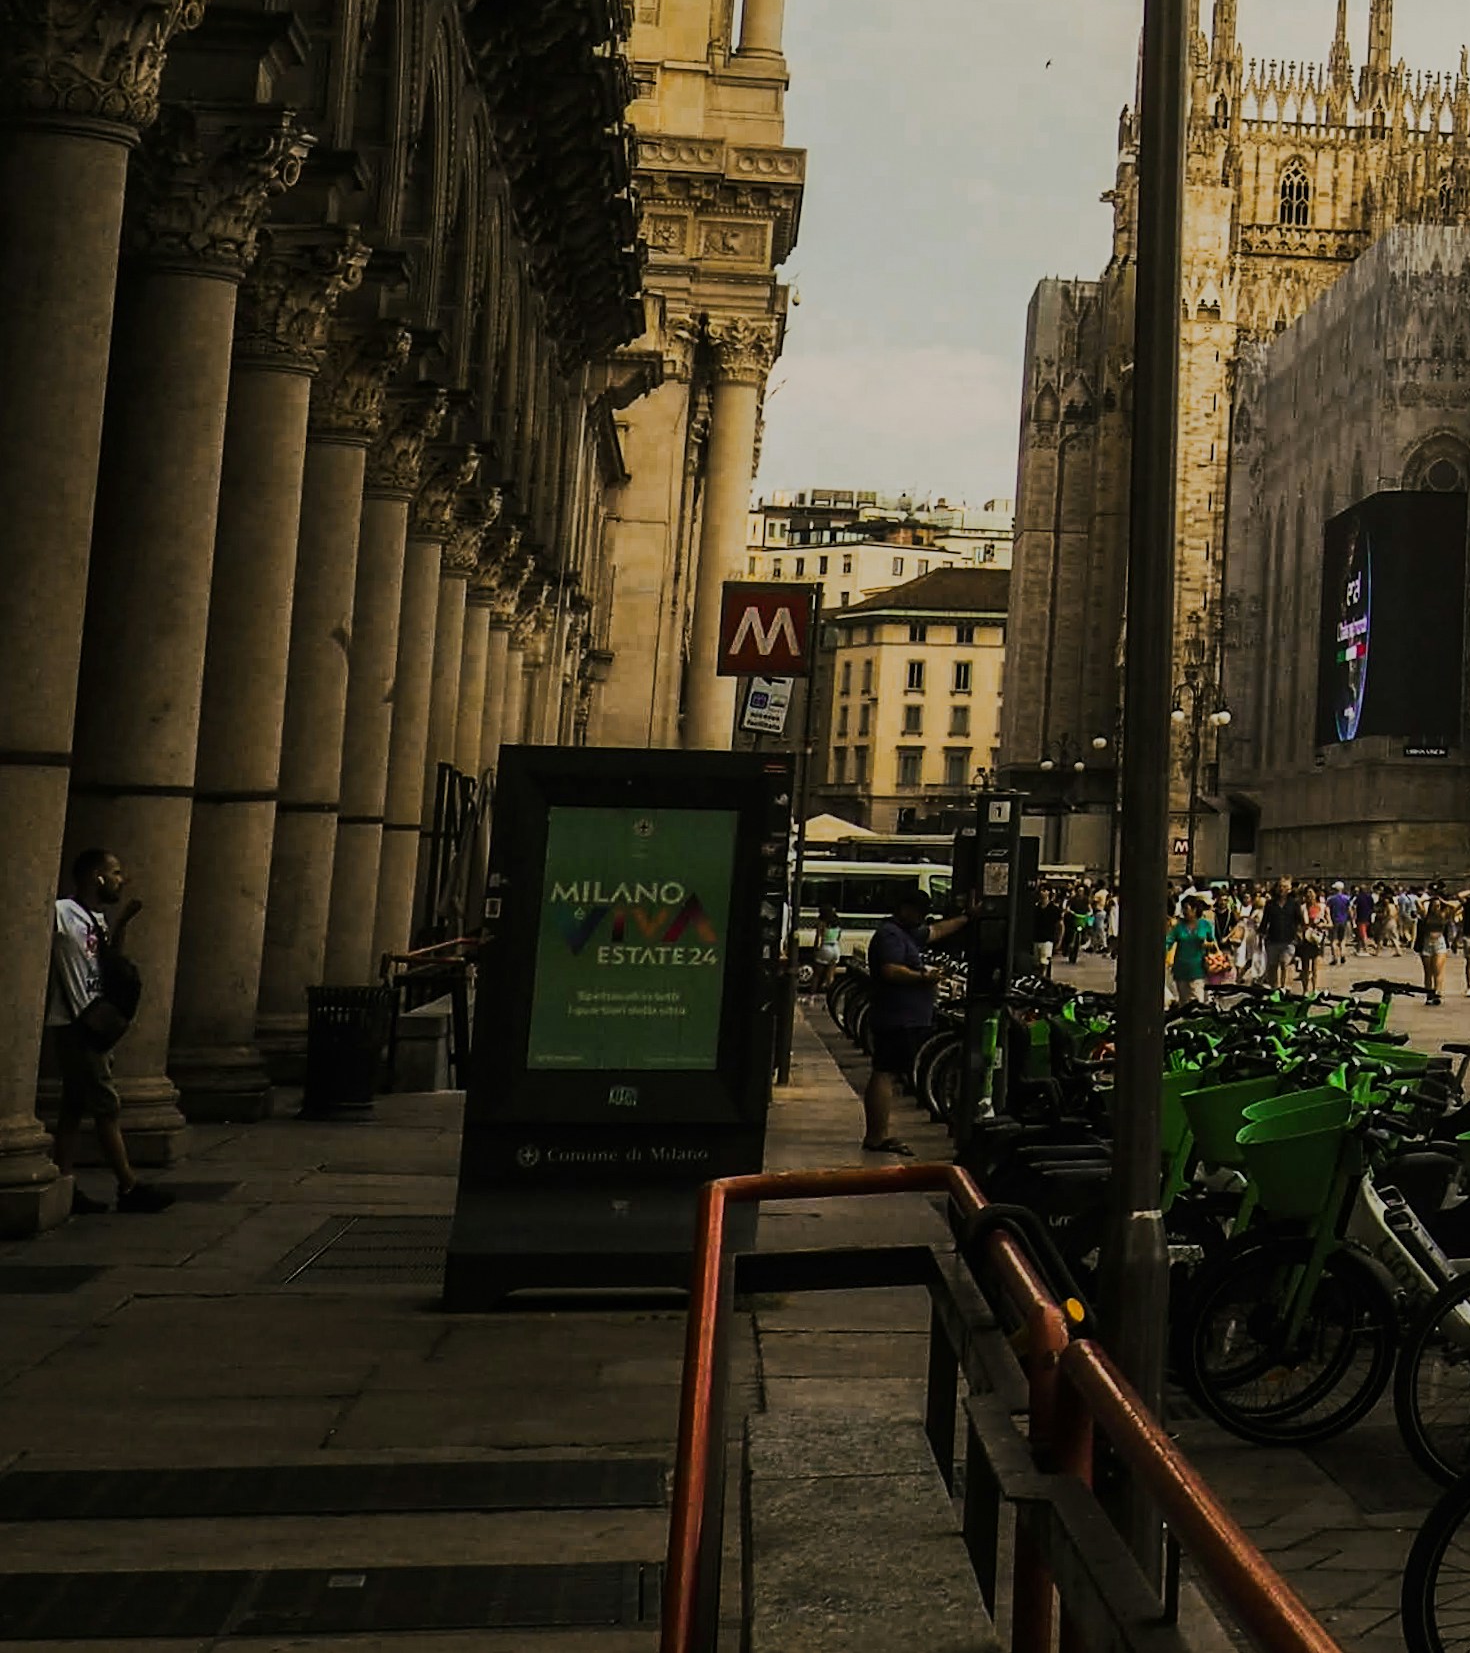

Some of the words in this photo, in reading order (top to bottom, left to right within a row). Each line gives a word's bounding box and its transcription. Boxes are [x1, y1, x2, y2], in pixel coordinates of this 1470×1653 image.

[728, 606, 801, 656] M
[1174, 840, 1190, 852] M
[550, 881, 686, 905] MILANO
[556, 894, 718, 956] VIVA
[546, 1147, 618, 1163] Comune
[626, 1147, 642, 1162] di
[651, 1147, 710, 1163] Milano
